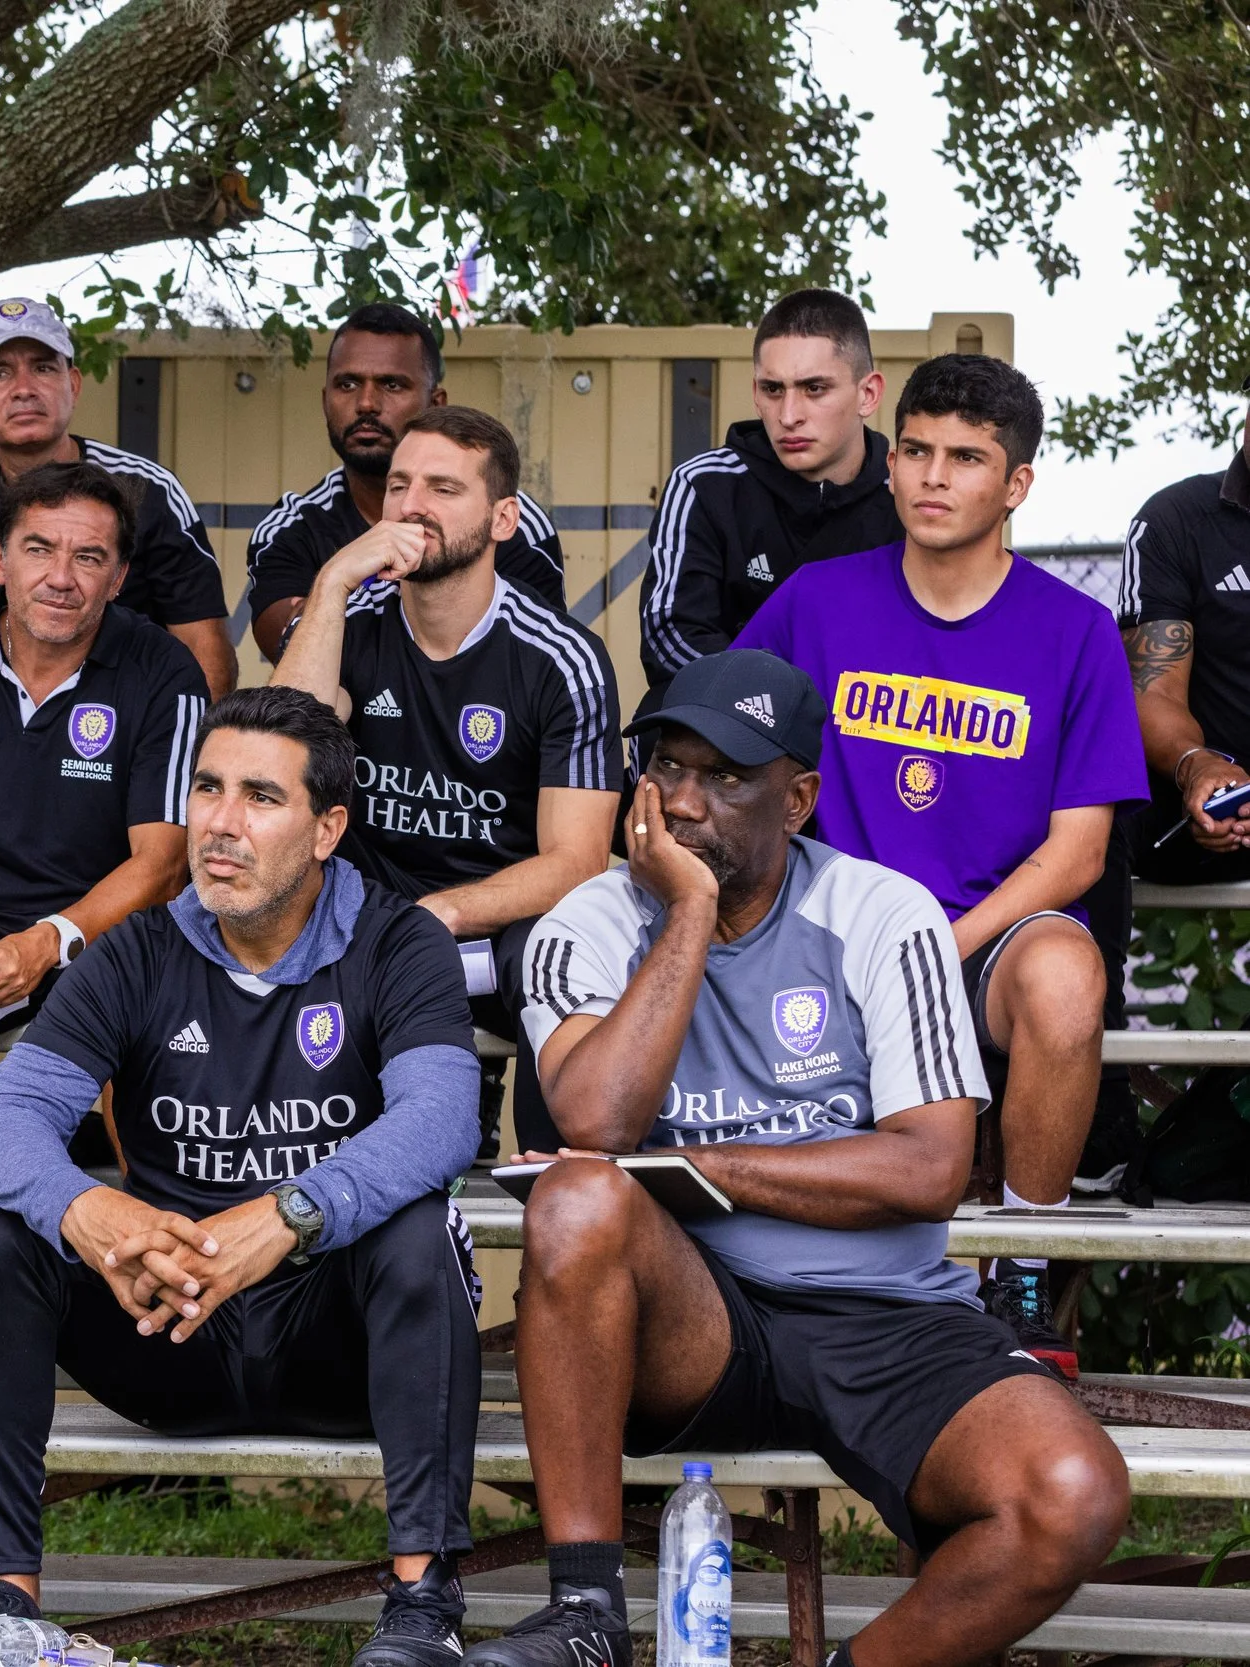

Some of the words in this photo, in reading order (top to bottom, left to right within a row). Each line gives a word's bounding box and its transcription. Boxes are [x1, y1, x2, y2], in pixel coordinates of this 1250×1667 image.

[364, 705, 402, 718] adidas
[735, 701, 776, 728] adidas
[845, 680, 1016, 749] ORLANDO
[467, 743, 494, 752] ORLANDO
[61, 759, 112, 773] SEMINOLE
[60, 769, 84, 778] SOCCER
[85, 772, 112, 781] SCHOOL
[903, 791, 932, 802] ORLANDO
[786, 1032, 820, 1044] ORLANDO
[797, 1040, 814, 1048] CITY
[169, 1039, 210, 1054] adidas
[774, 1060, 805, 1074] LAKE
[804, 1051, 840, 1069] NONA
[775, 1073, 808, 1083] SOCCER
[808, 1064, 842, 1079] SCHOOL
[151, 1094, 356, 1140] ORLANDO
